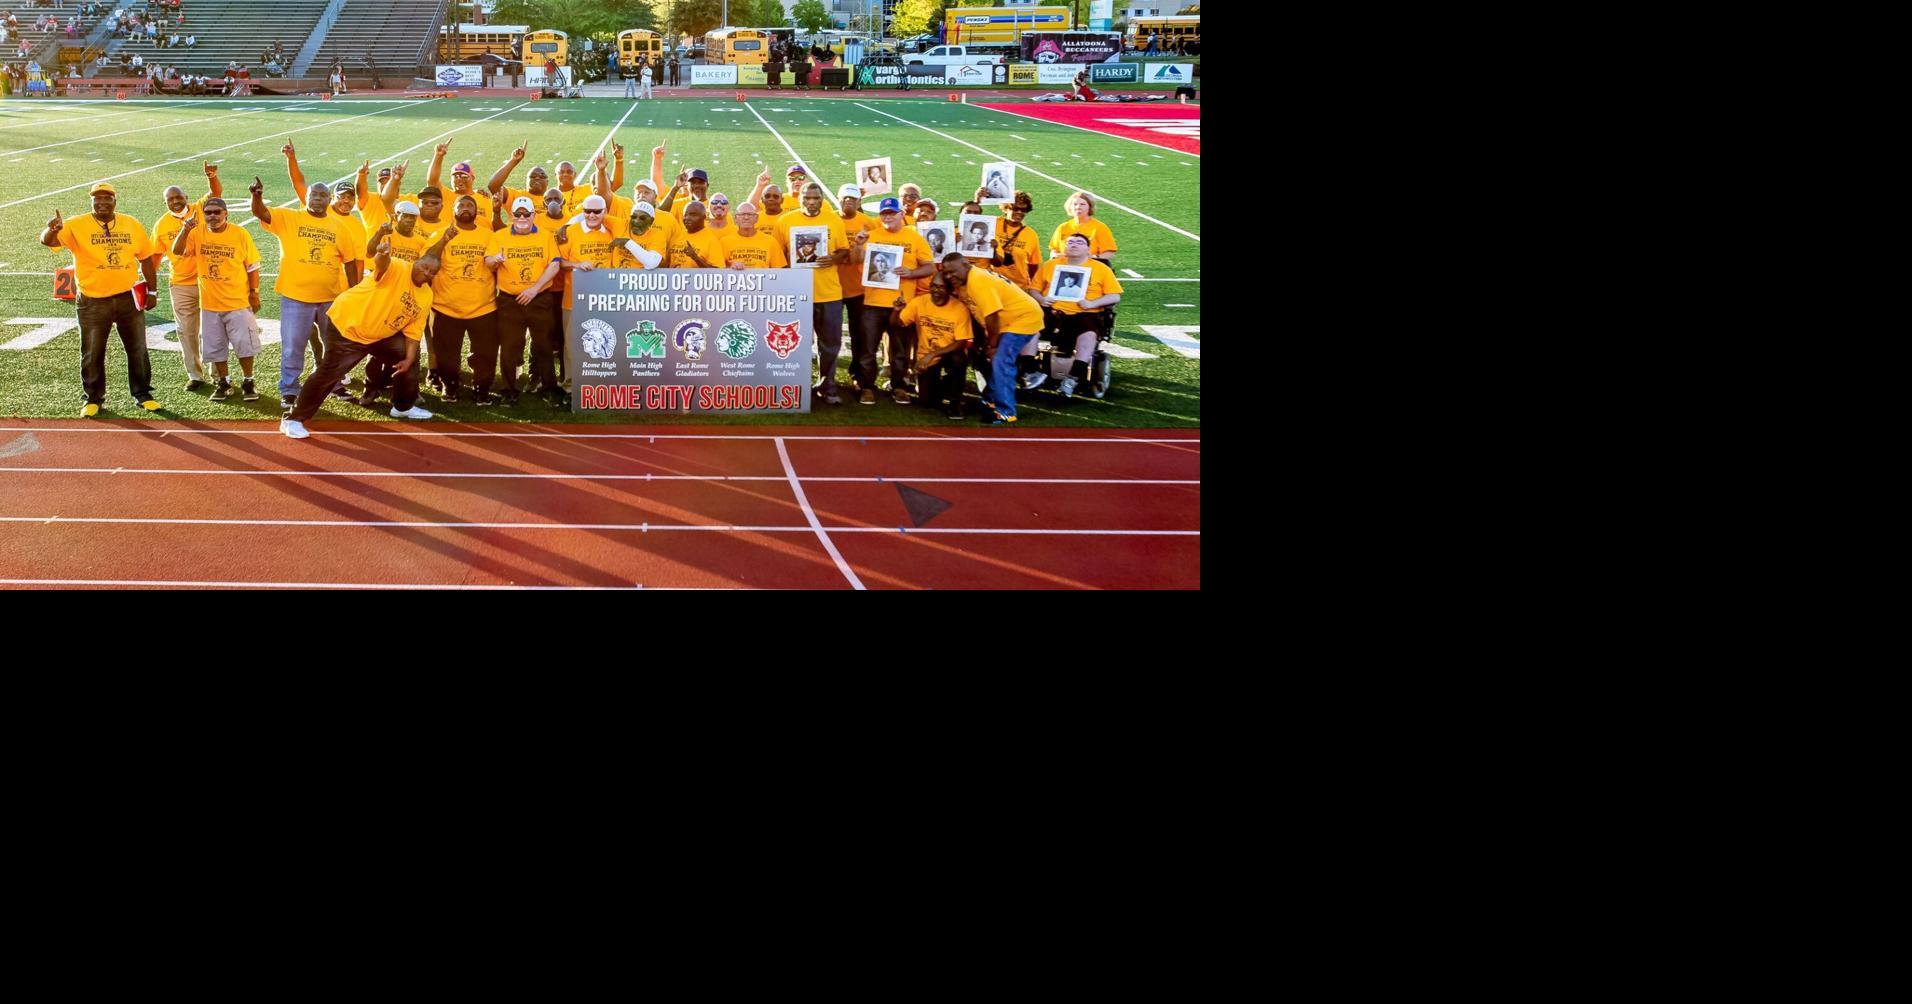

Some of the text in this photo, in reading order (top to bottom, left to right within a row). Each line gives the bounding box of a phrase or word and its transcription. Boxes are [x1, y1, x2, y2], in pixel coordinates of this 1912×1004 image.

[1096, 69, 1134, 77] HARDY
[298, 232, 336, 243] CHAMPIONS
[507, 251, 543, 259] CHAMPIONS
[619, 274, 668, 291] PROUD
[672, 274, 689, 291] OF
[692, 274, 724, 291] OUR
[728, 274, 765, 291] PAST
[588, 294, 670, 312] PREPARING
[675, 295, 705, 312] FOR
[708, 295, 736, 312] OUR
[739, 295, 796, 312] FUTURE
[601, 362, 617, 371] High
[647, 362, 663, 371] High
[785, 362, 800, 371] High
[581, 370, 617, 378] Hilltoppers
[722, 370, 755, 378] Chieftains
[581, 385, 803, 410] ROME CITY SCHOOLS!
